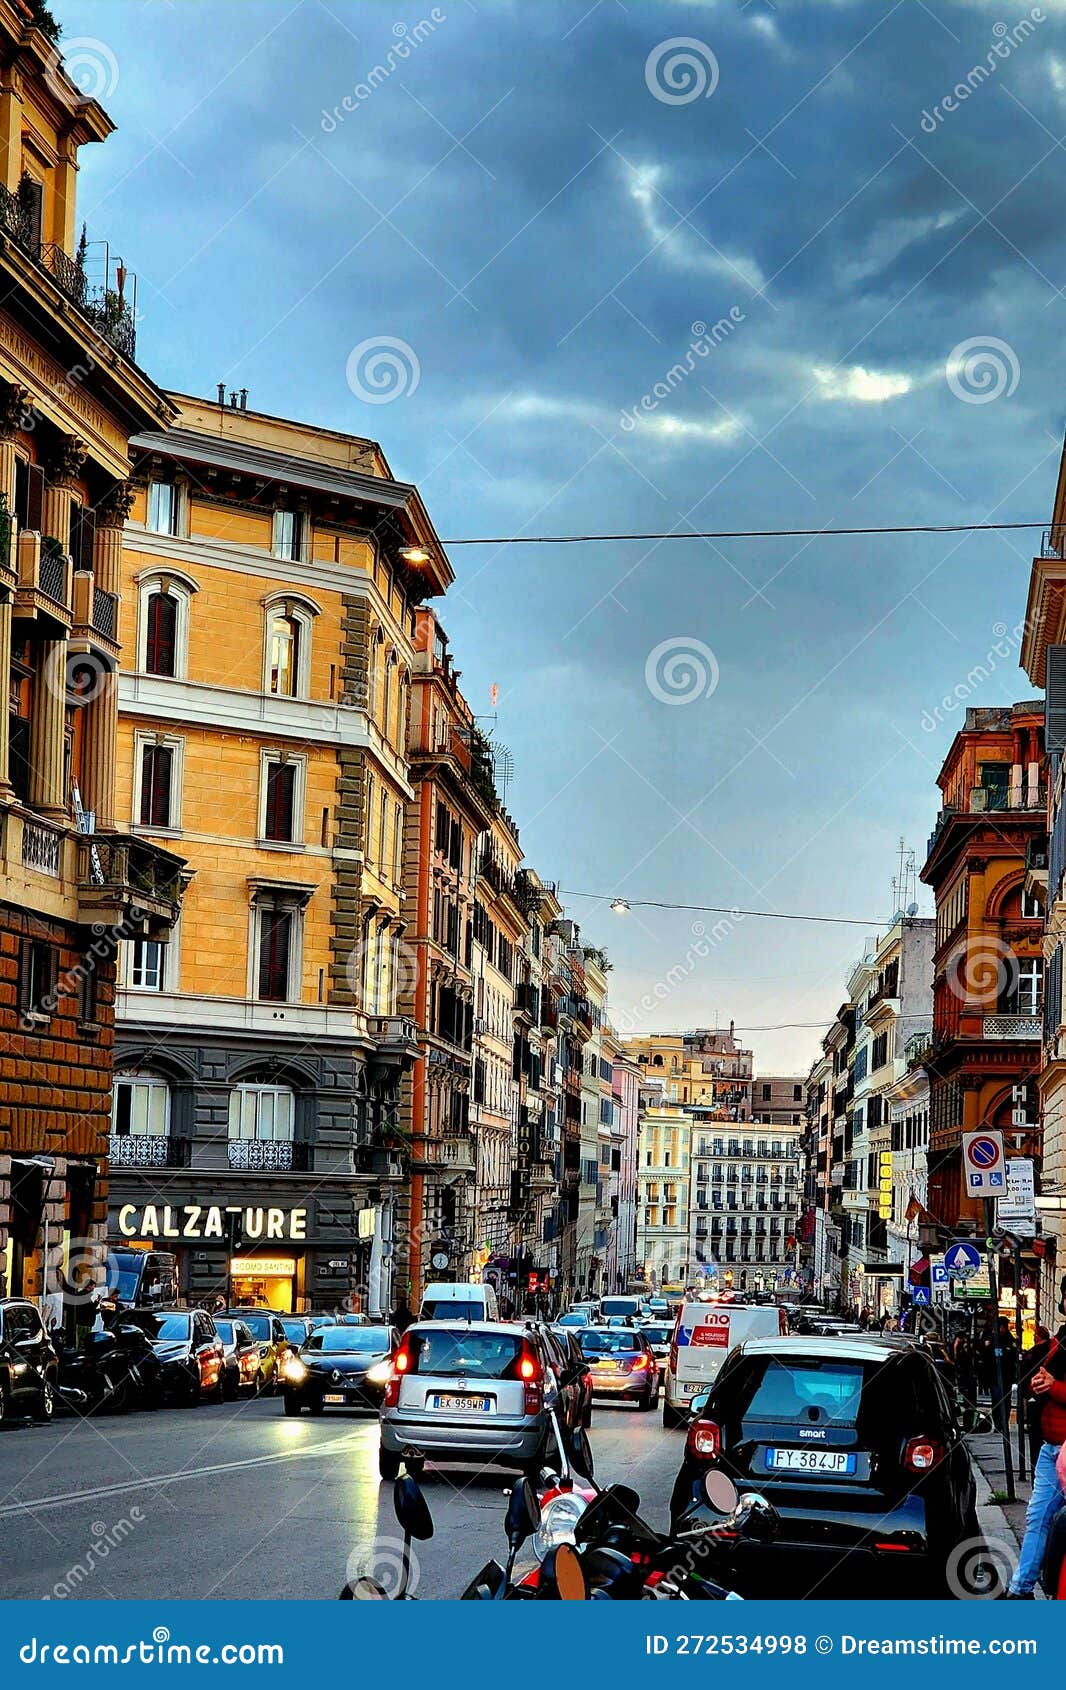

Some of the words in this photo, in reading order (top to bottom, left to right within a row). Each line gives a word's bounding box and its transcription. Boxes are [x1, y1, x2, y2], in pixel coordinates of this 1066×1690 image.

[1012, 1085, 1027, 1149] HOT
[519, 1126, 530, 1199] HOTEL
[880, 1152, 891, 1218] HOTEL
[440, 1398, 451, 1407] EK
[455, 1398, 484, 1410] 959WR
[799, 1429, 826, 1438] smart
[776, 1451, 794, 1466] FY
[800, 1452, 846, 1470] 384JP
